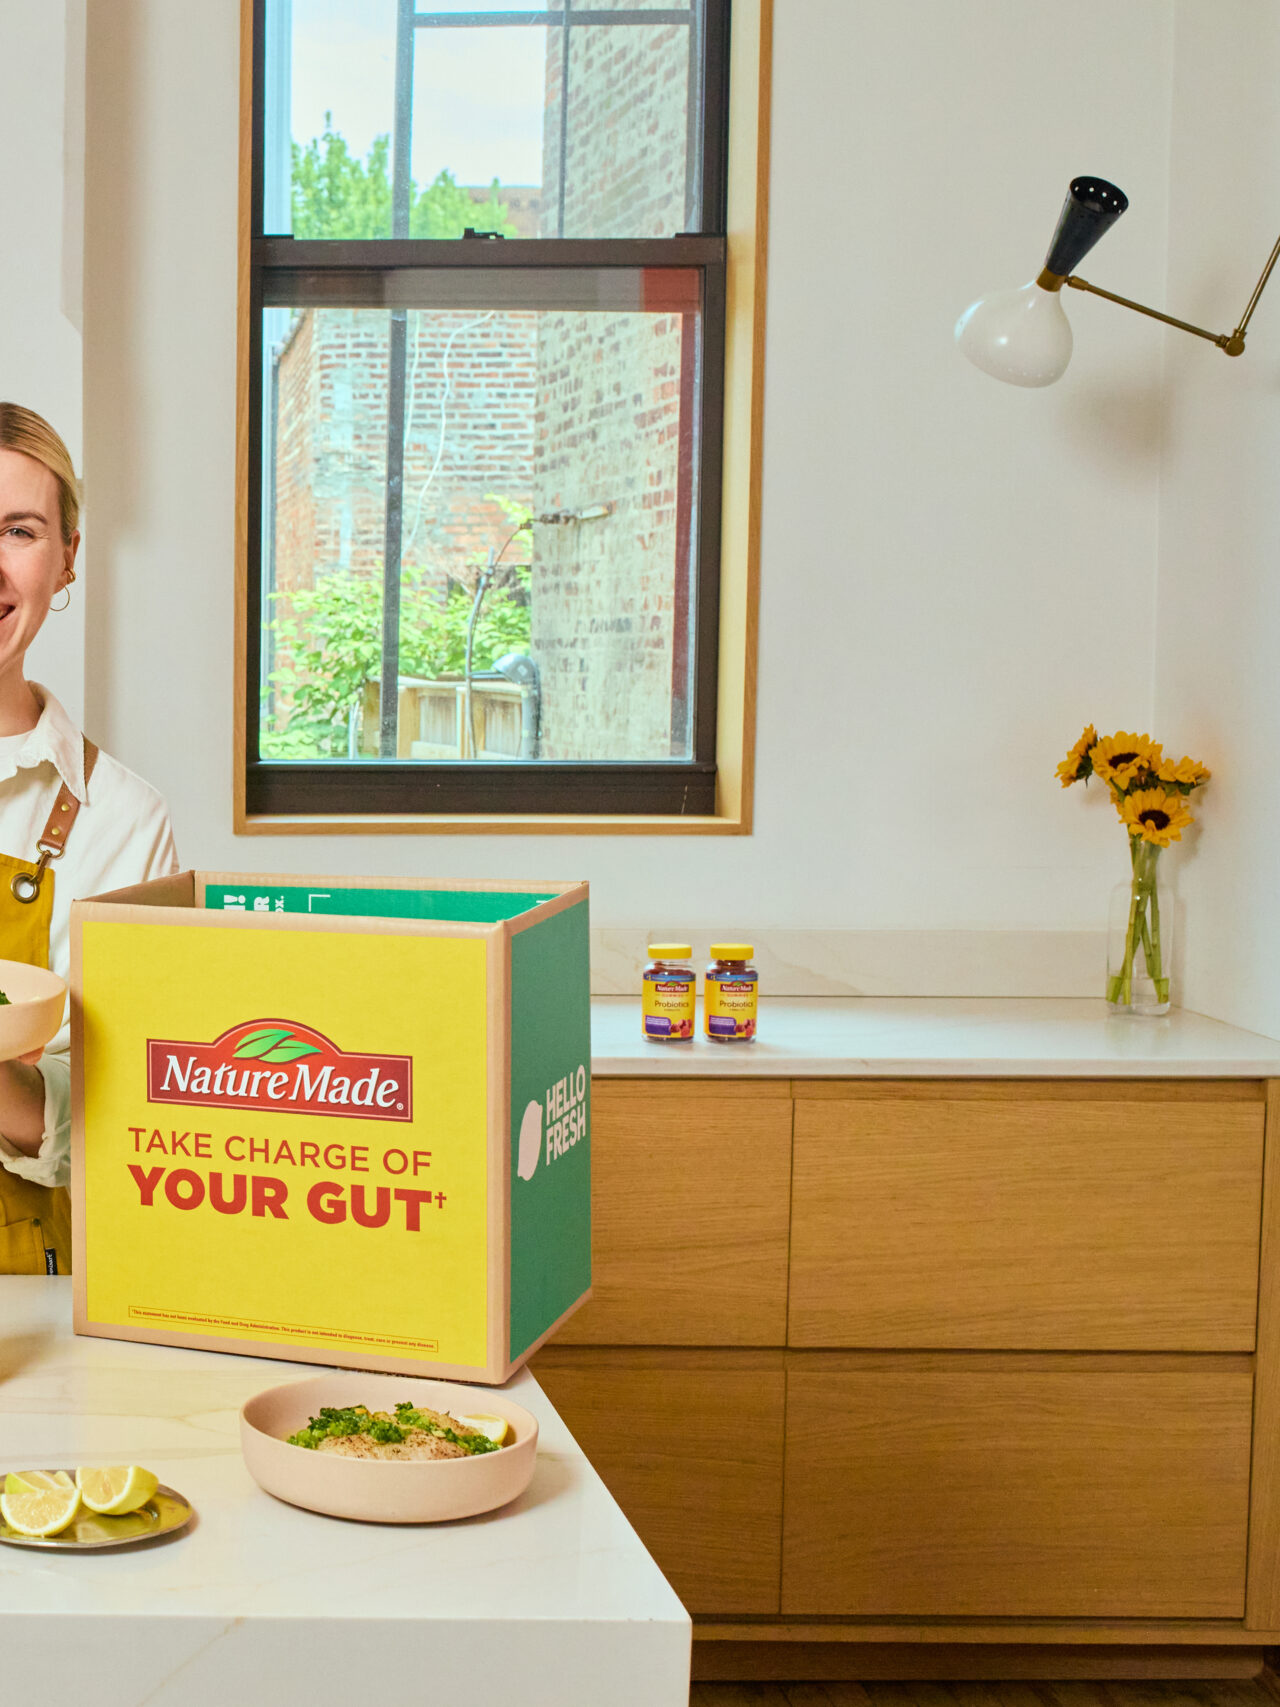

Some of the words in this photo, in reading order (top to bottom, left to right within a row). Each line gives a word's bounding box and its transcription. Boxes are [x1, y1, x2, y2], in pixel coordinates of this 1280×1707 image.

[160, 1054, 289, 1100] Nature
[545, 1064, 586, 1127] HELLO
[128, 1127, 213, 1158] TAKE
[224, 1135, 370, 1172] CHARGE
[382, 1148, 432, 1176] OF
[545, 1100, 586, 1166] FRESH
[126, 1164, 290, 1220] YOUR
